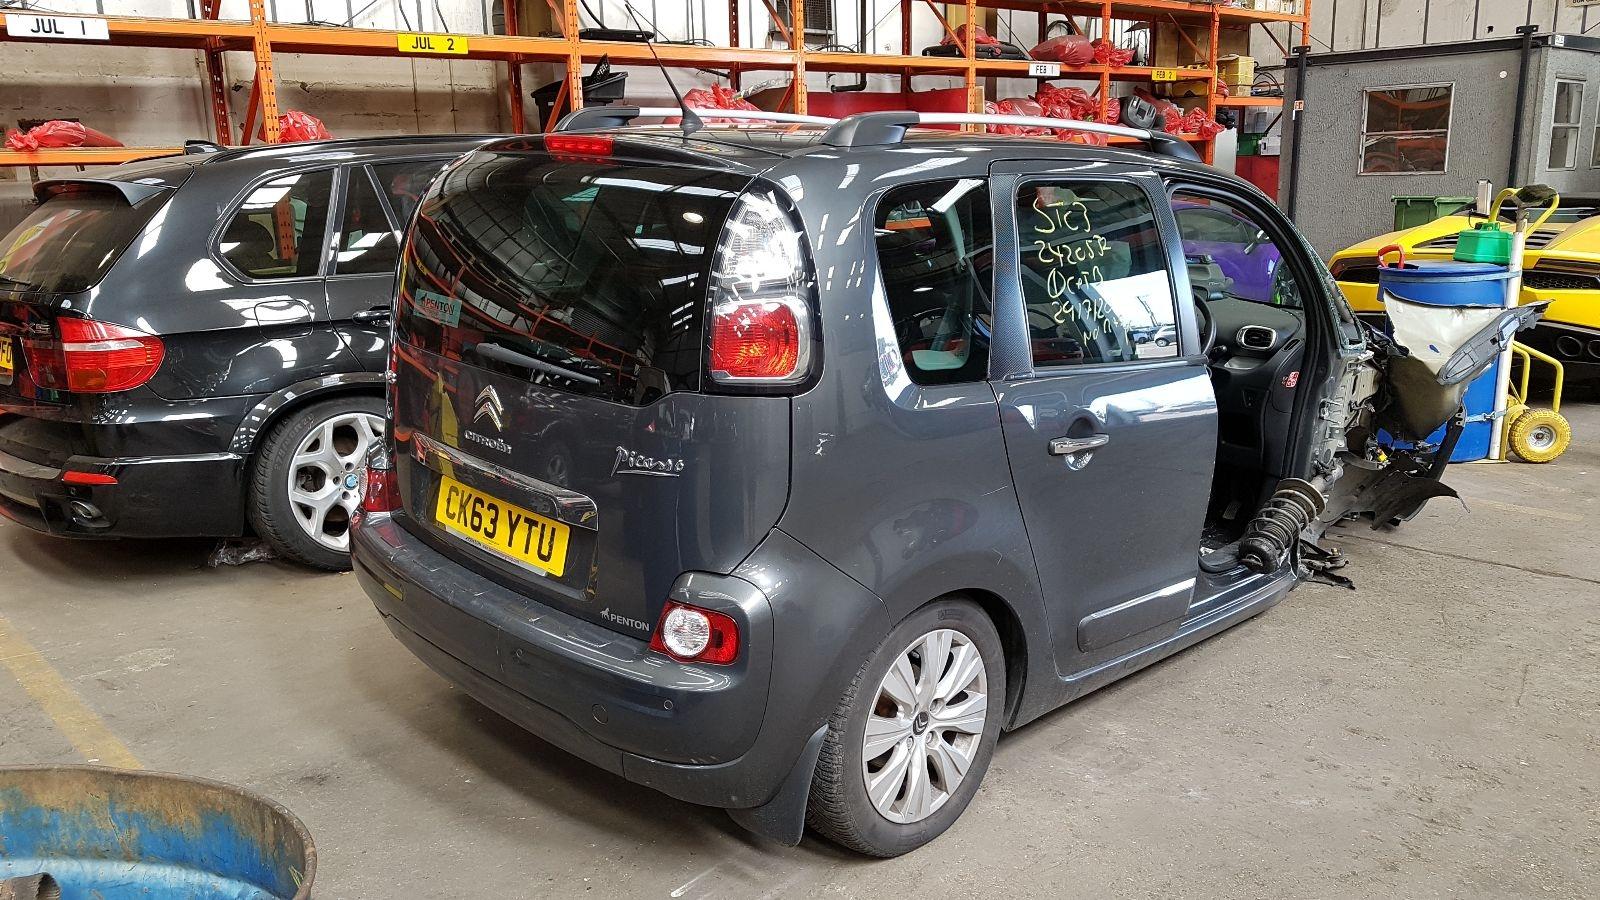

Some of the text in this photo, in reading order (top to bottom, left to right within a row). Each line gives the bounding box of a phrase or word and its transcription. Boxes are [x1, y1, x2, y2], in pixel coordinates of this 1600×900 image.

[30, 18, 65, 35] JUL
[411, 36, 455, 51] JUL 2
[1035, 65, 1047, 75] FEB
[1156, 70, 1173, 80] FEB 2
[425, 297, 455, 316] PENTON
[610, 445, 685, 477] Picasso
[445, 485, 500, 540] CK63
[507, 509, 557, 562] YTU
[610, 613, 650, 632] PENTON
